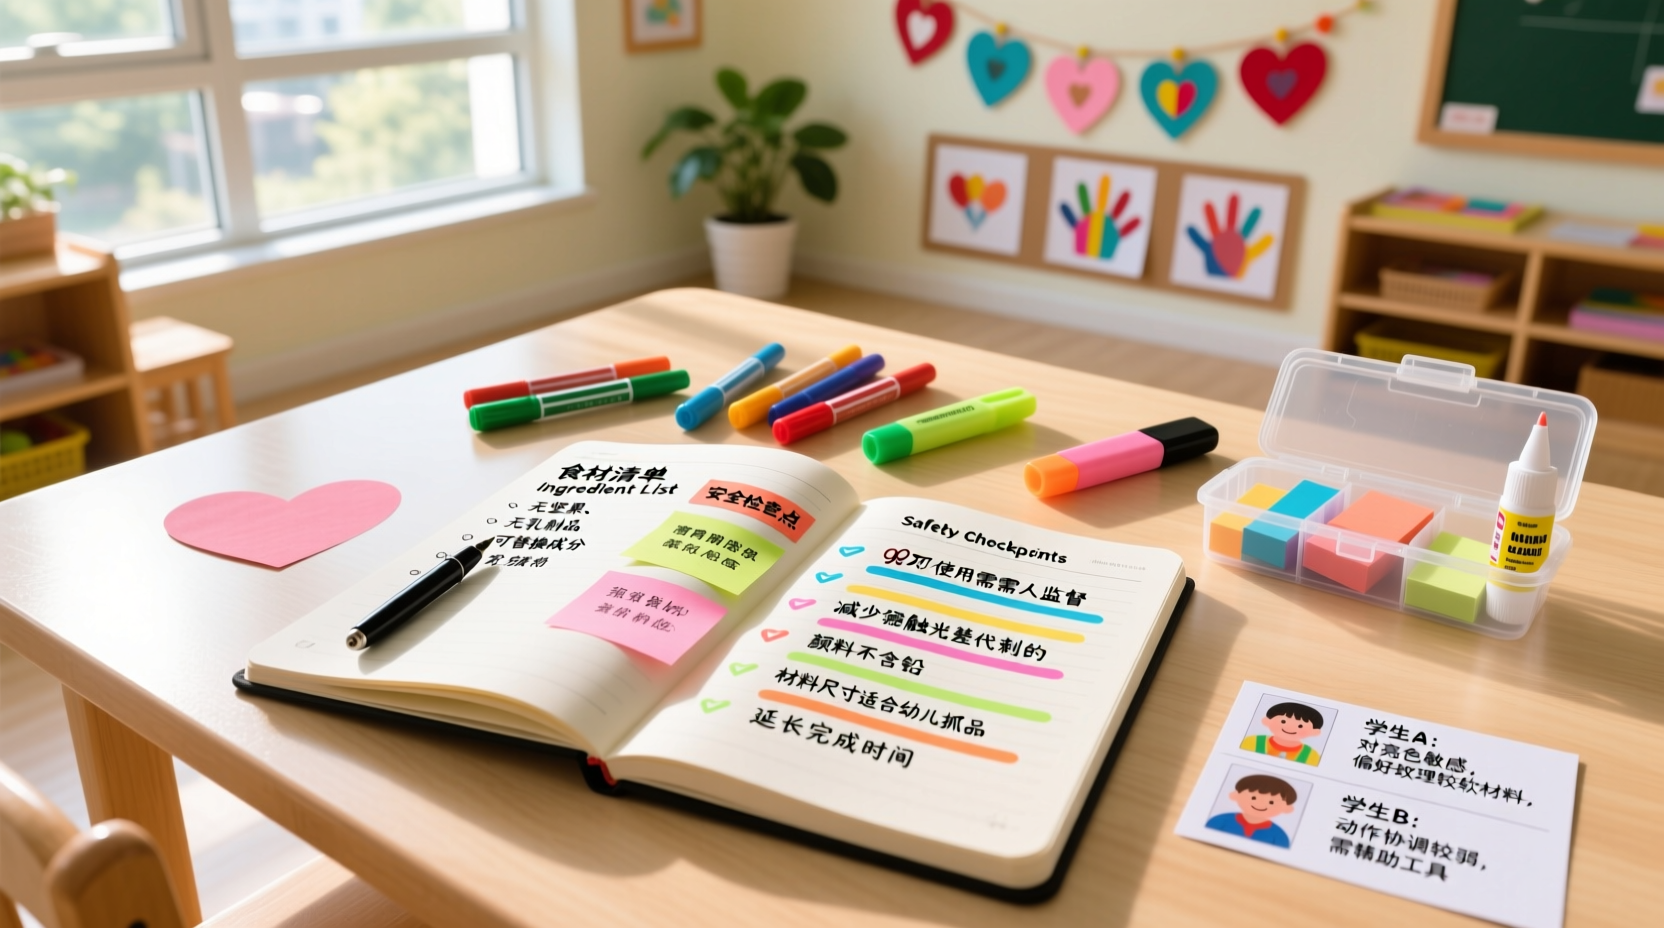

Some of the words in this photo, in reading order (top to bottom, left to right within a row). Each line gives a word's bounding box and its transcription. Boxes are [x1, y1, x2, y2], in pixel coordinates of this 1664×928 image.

[558, 463, 668, 483] 食材清单
[901, 516, 959, 538] Safety
[807, 633, 925, 676] 颜料不含铅
[749, 707, 915, 769] 延长完成时间
[1329, 836, 1447, 882] 需辅助工具
